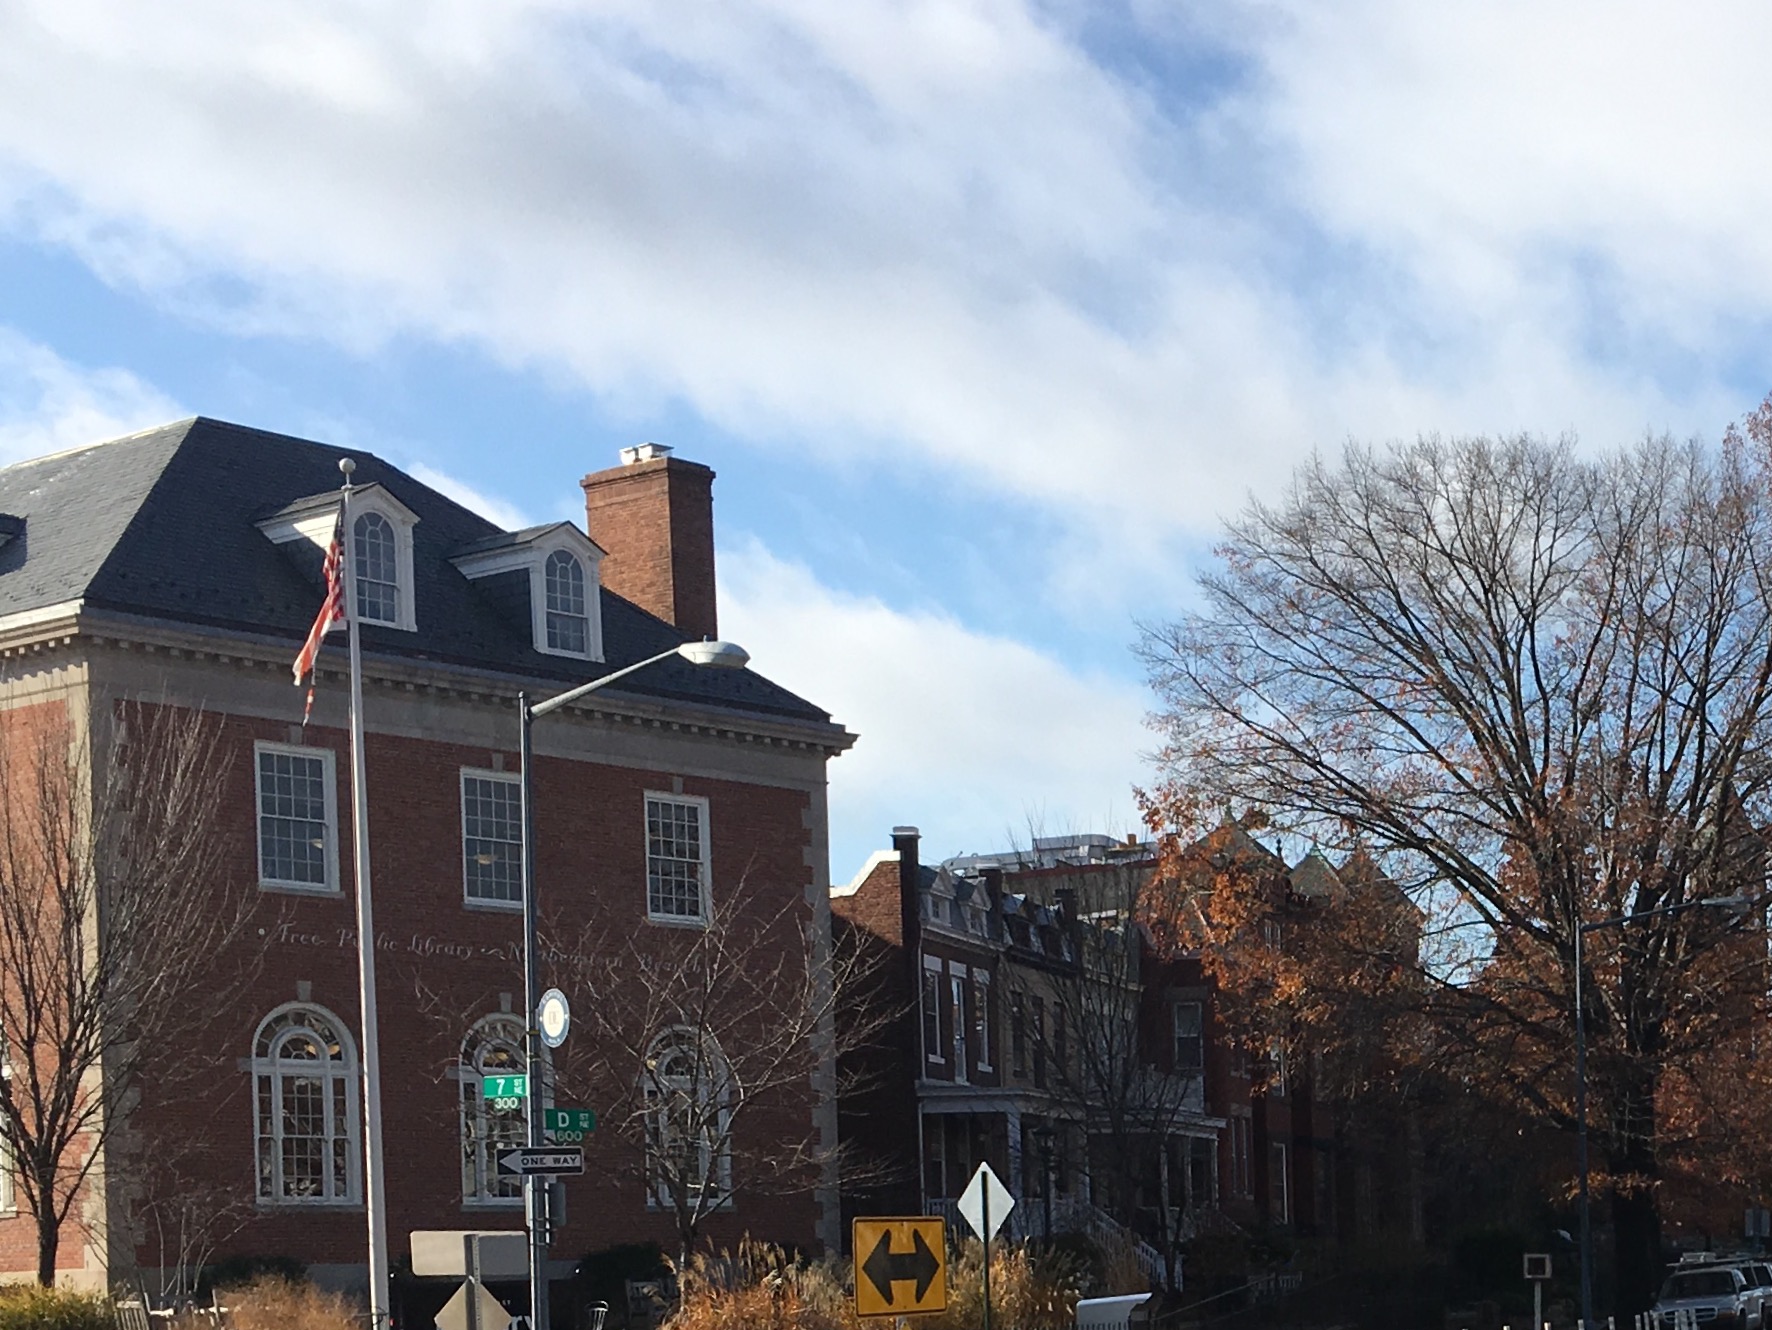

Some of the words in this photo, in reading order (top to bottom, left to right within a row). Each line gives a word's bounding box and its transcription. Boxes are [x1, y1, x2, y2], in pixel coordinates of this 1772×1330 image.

[277, 921, 326, 945] Free
[407, 934, 473, 960] Library
[496, 1079, 506, 1095] 7
[514, 1078, 523, 1086] ST
[494, 1097, 518, 1109] 300
[557, 1112, 570, 1128] D
[556, 1130, 583, 1142] 600
[521, 1157, 546, 1166] ONE
[552, 1156, 578, 1165] WAY
